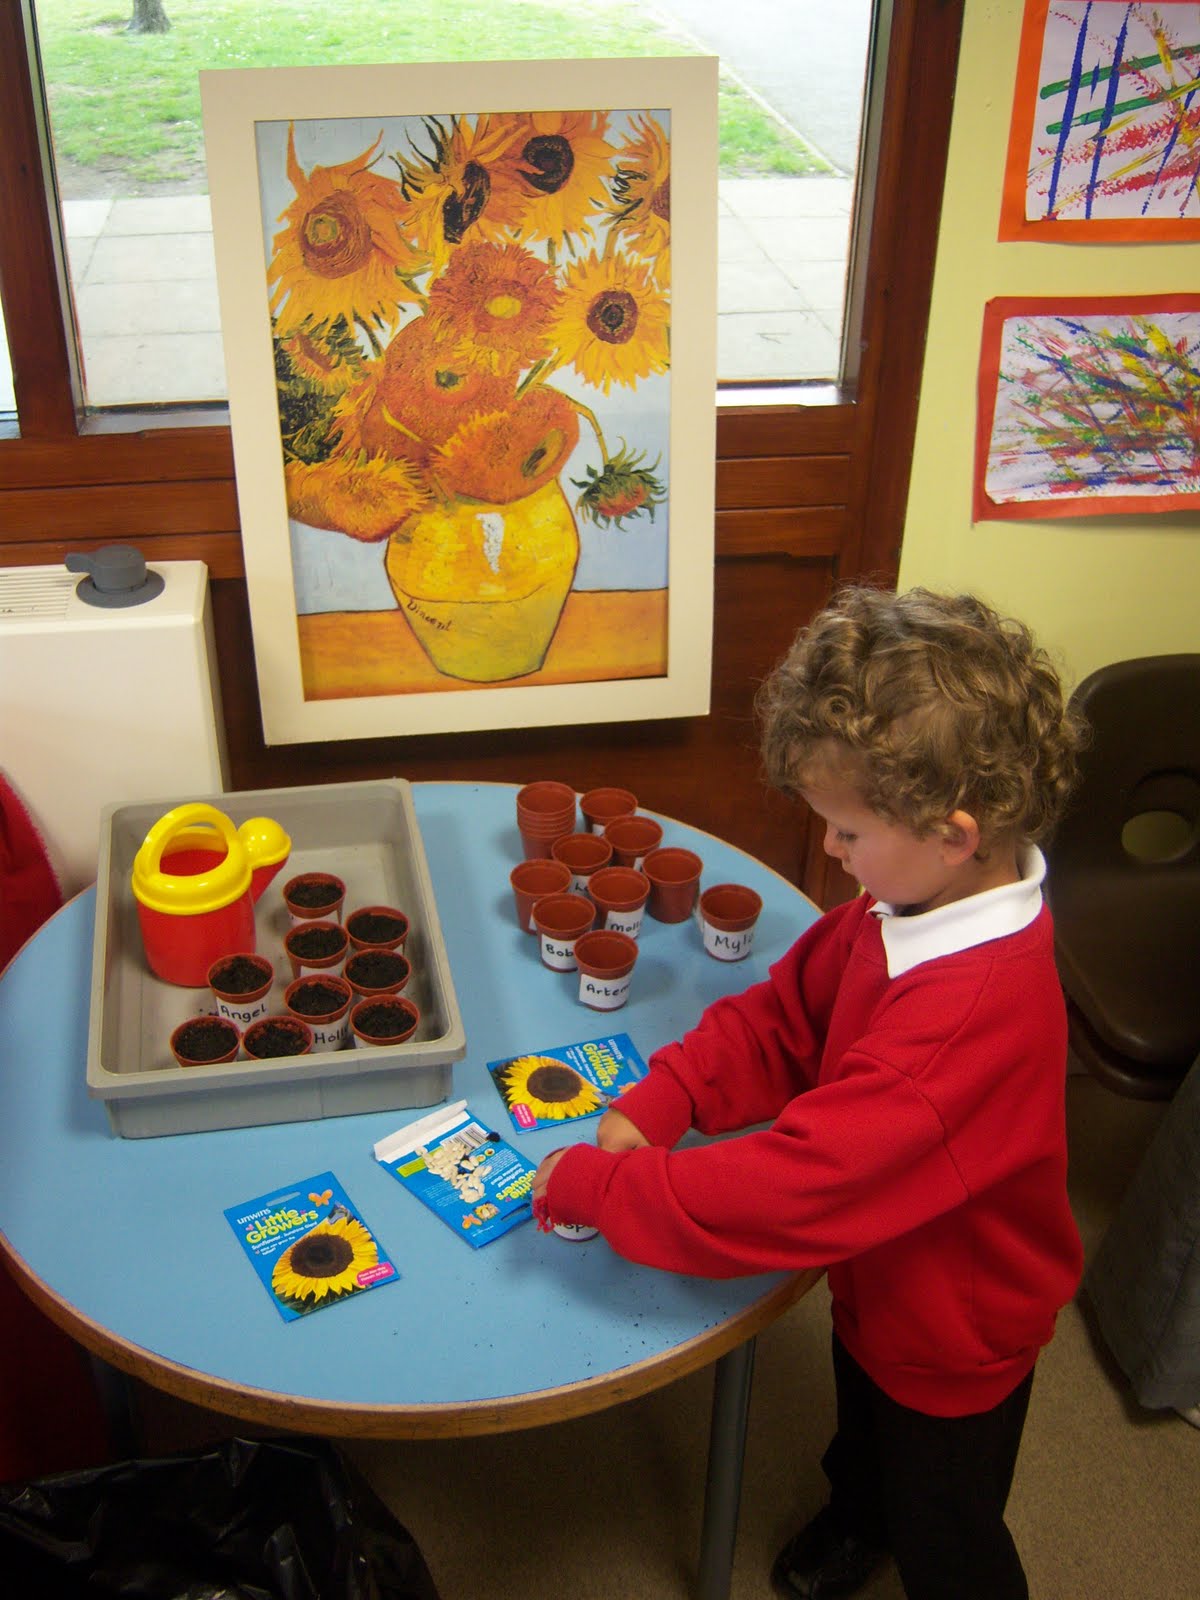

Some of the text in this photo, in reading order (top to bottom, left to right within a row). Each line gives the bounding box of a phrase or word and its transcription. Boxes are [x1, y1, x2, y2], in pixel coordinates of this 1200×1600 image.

[220, 1003, 267, 1023] Angel
[582, 1043, 614, 1087] Growers
[236, 1207, 272, 1225] unwins
[245, 1208, 319, 1244] Growers
[254, 1208, 300, 1233] Little
